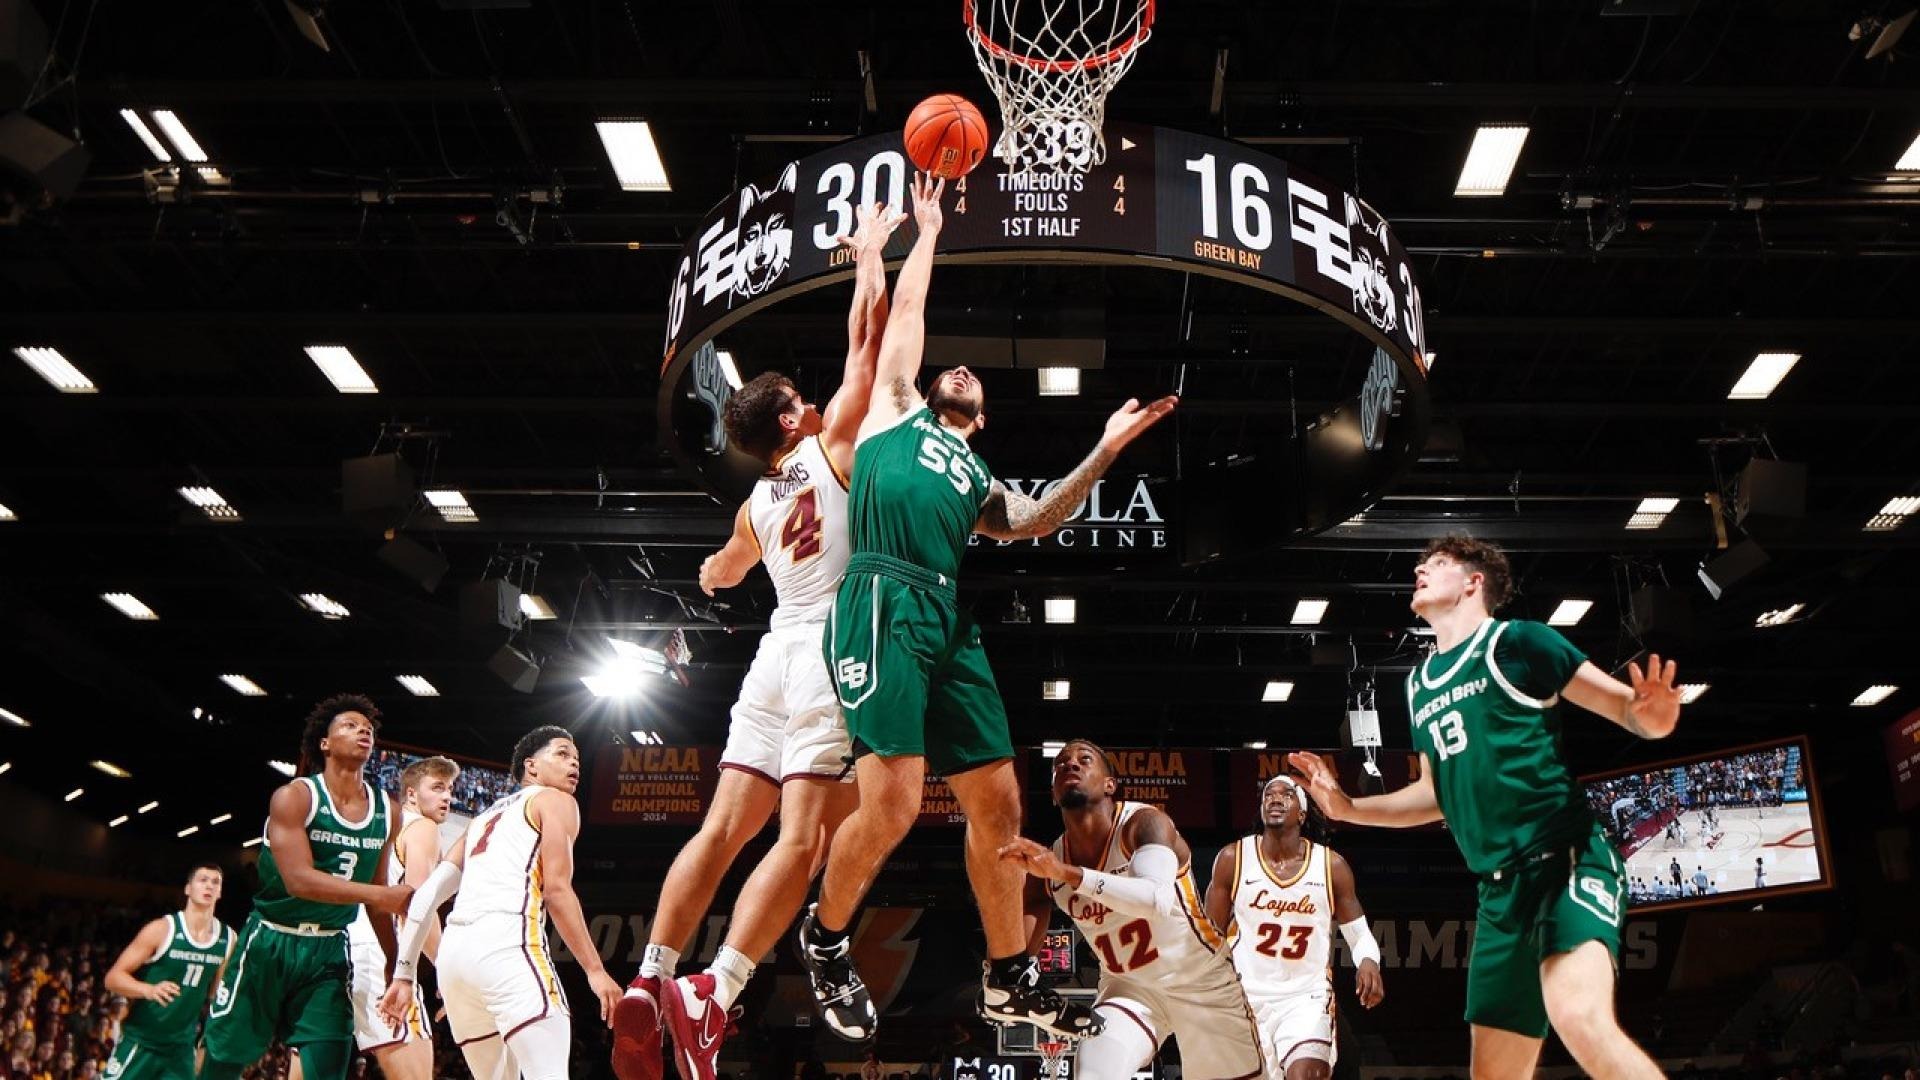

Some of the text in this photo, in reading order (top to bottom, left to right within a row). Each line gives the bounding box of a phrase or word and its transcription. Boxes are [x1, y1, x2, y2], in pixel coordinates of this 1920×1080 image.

[955, 173, 1125, 193] 4 TIMEOUTS 4
[813, 151, 905, 250] 30
[954, 193, 1126, 216] 4 FOULS 4
[1186, 153, 1272, 250] 16
[1001, 218, 1081, 238] 1ST HALF
[1194, 241, 1261, 271] GREEN BAY
[918, 437, 971, 495] 55
[781, 485, 824, 565] 4
[838, 656, 868, 690] GB
[1451, 677, 1488, 703] BAY
[1428, 710, 1468, 761] 13
[620, 748, 700, 773] NCAA
[1104, 752, 1186, 777] NCAA
[620, 782, 696, 796] NATIONAL
[647, 773, 700, 781] VOLLEYBALL
[1133, 777, 1187, 785] BASKETBALL
[1123, 786, 1169, 799] FINAL
[611, 799, 701, 812] CHAMPIONS
[641, 812, 667, 822] 2014
[309, 829, 385, 850] GREEN BAY
[332, 851, 358, 881] 3
[1249, 889, 1317, 918] Loyola
[1043, 935, 1069, 948] 4:39
[1094, 917, 1159, 973] 12
[1255, 922, 1314, 961] 23
[182, 962, 204, 987] 11
